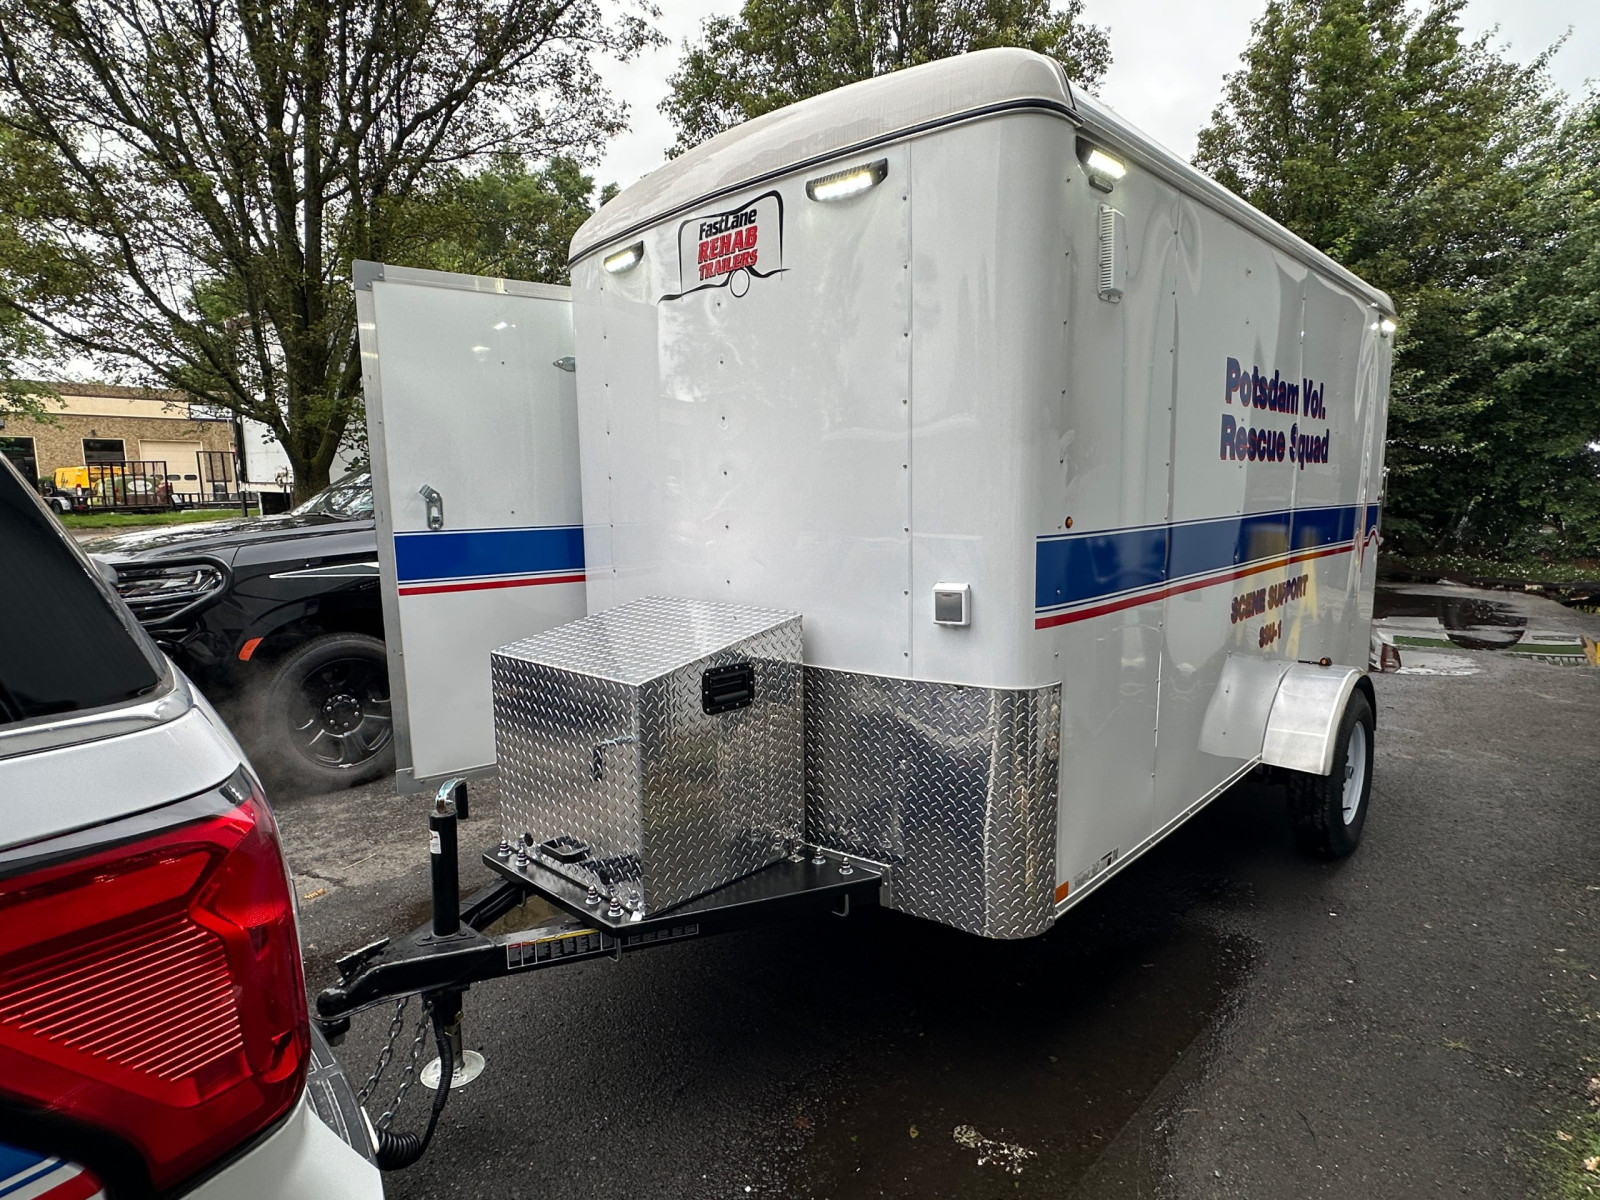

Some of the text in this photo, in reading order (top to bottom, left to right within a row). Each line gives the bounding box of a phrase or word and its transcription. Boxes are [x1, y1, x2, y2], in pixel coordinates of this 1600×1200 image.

[698, 225, 758, 264] REHAB
[699, 209, 758, 241] FastLane
[698, 249, 758, 281] TRAILERS
[1225, 356, 1326, 420] Potsdam Vol.
[1220, 413, 1330, 470] Rescue Squad
[1230, 573, 1309, 624] SCENE SUPPORT
